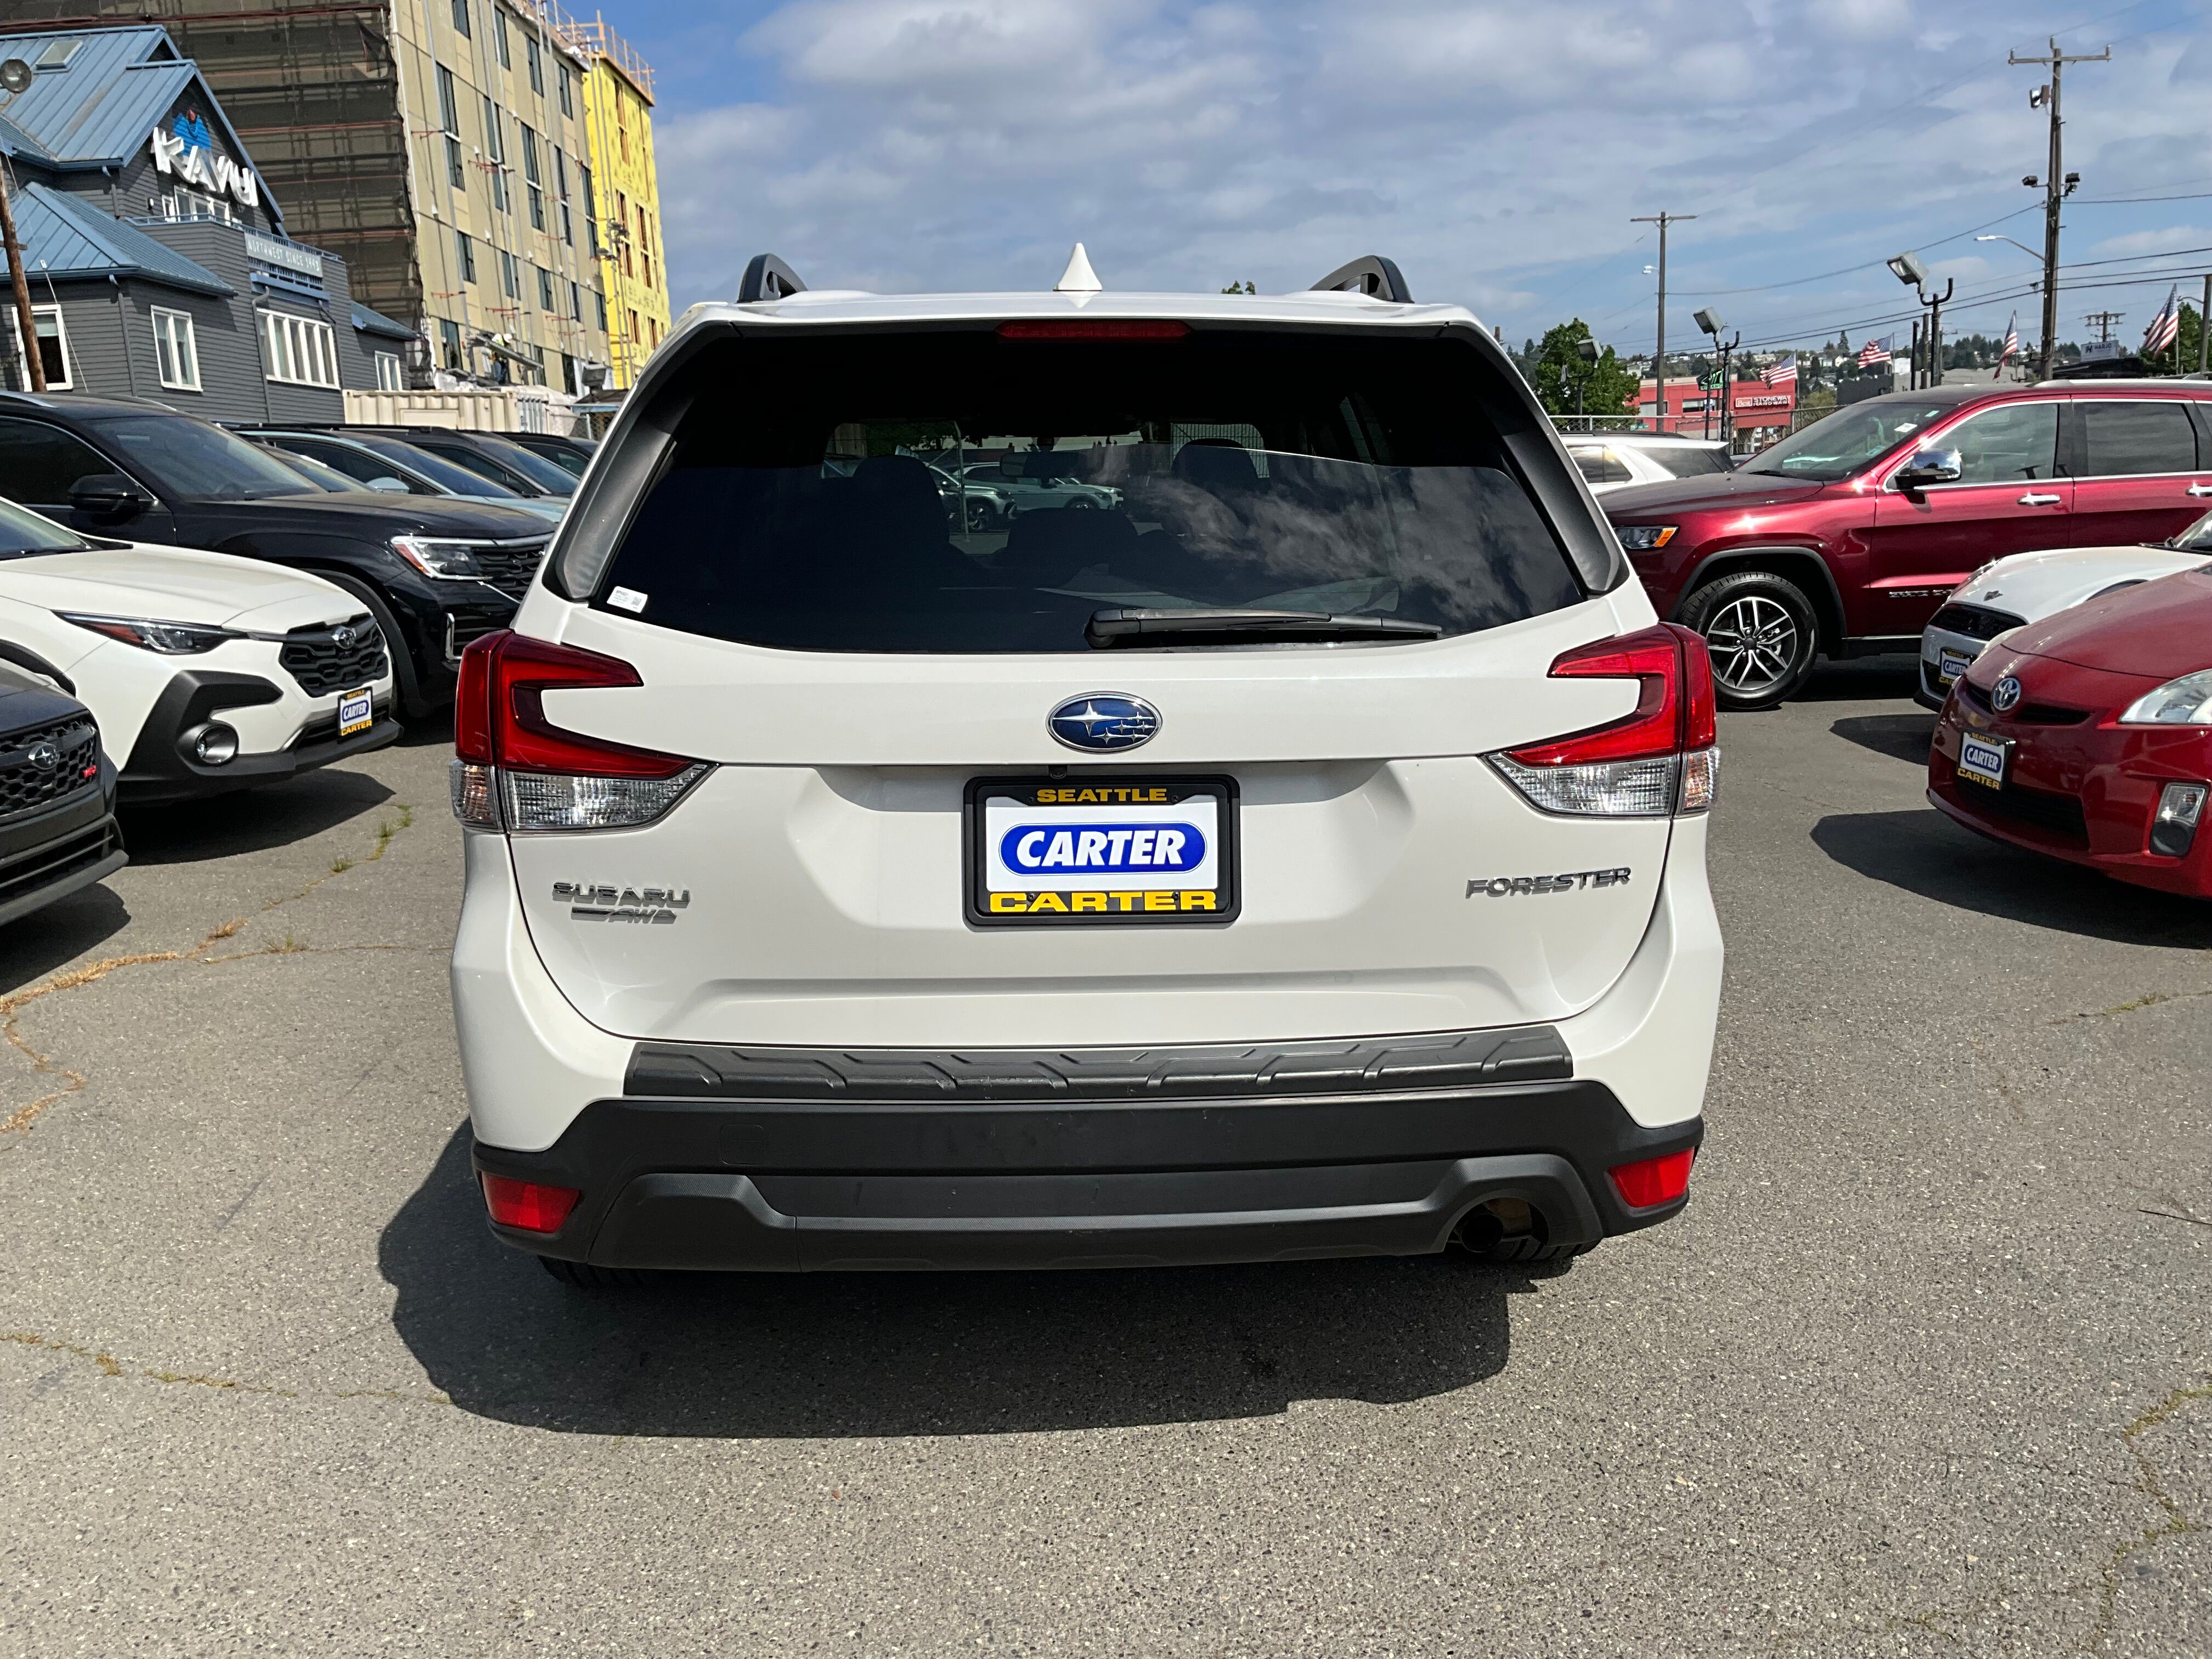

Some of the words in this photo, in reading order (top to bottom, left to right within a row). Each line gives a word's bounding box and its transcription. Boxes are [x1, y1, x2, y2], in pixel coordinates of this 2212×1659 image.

[153, 127, 258, 206] KAVU
[248, 240, 283, 259] NORTHWEST
[285, 251, 303, 267] SINCE
[1753, 395, 1791, 403] STONEWAY
[343, 702, 367, 720] CARTER
[341, 720, 372, 736] CARTER
[1971, 732, 1997, 746] SEATTLE
[1967, 747, 1999, 770] CARTER
[1957, 768, 2000, 790] CARTER
[1037, 788, 1167, 803] SEATTLE
[1016, 830, 1186, 867] CARTER
[1465, 867, 1631, 899] FORESTER
[552, 882, 690, 909] SUBARU
[989, 891, 1217, 912] CARTER
[608, 908, 676, 924] AWD
